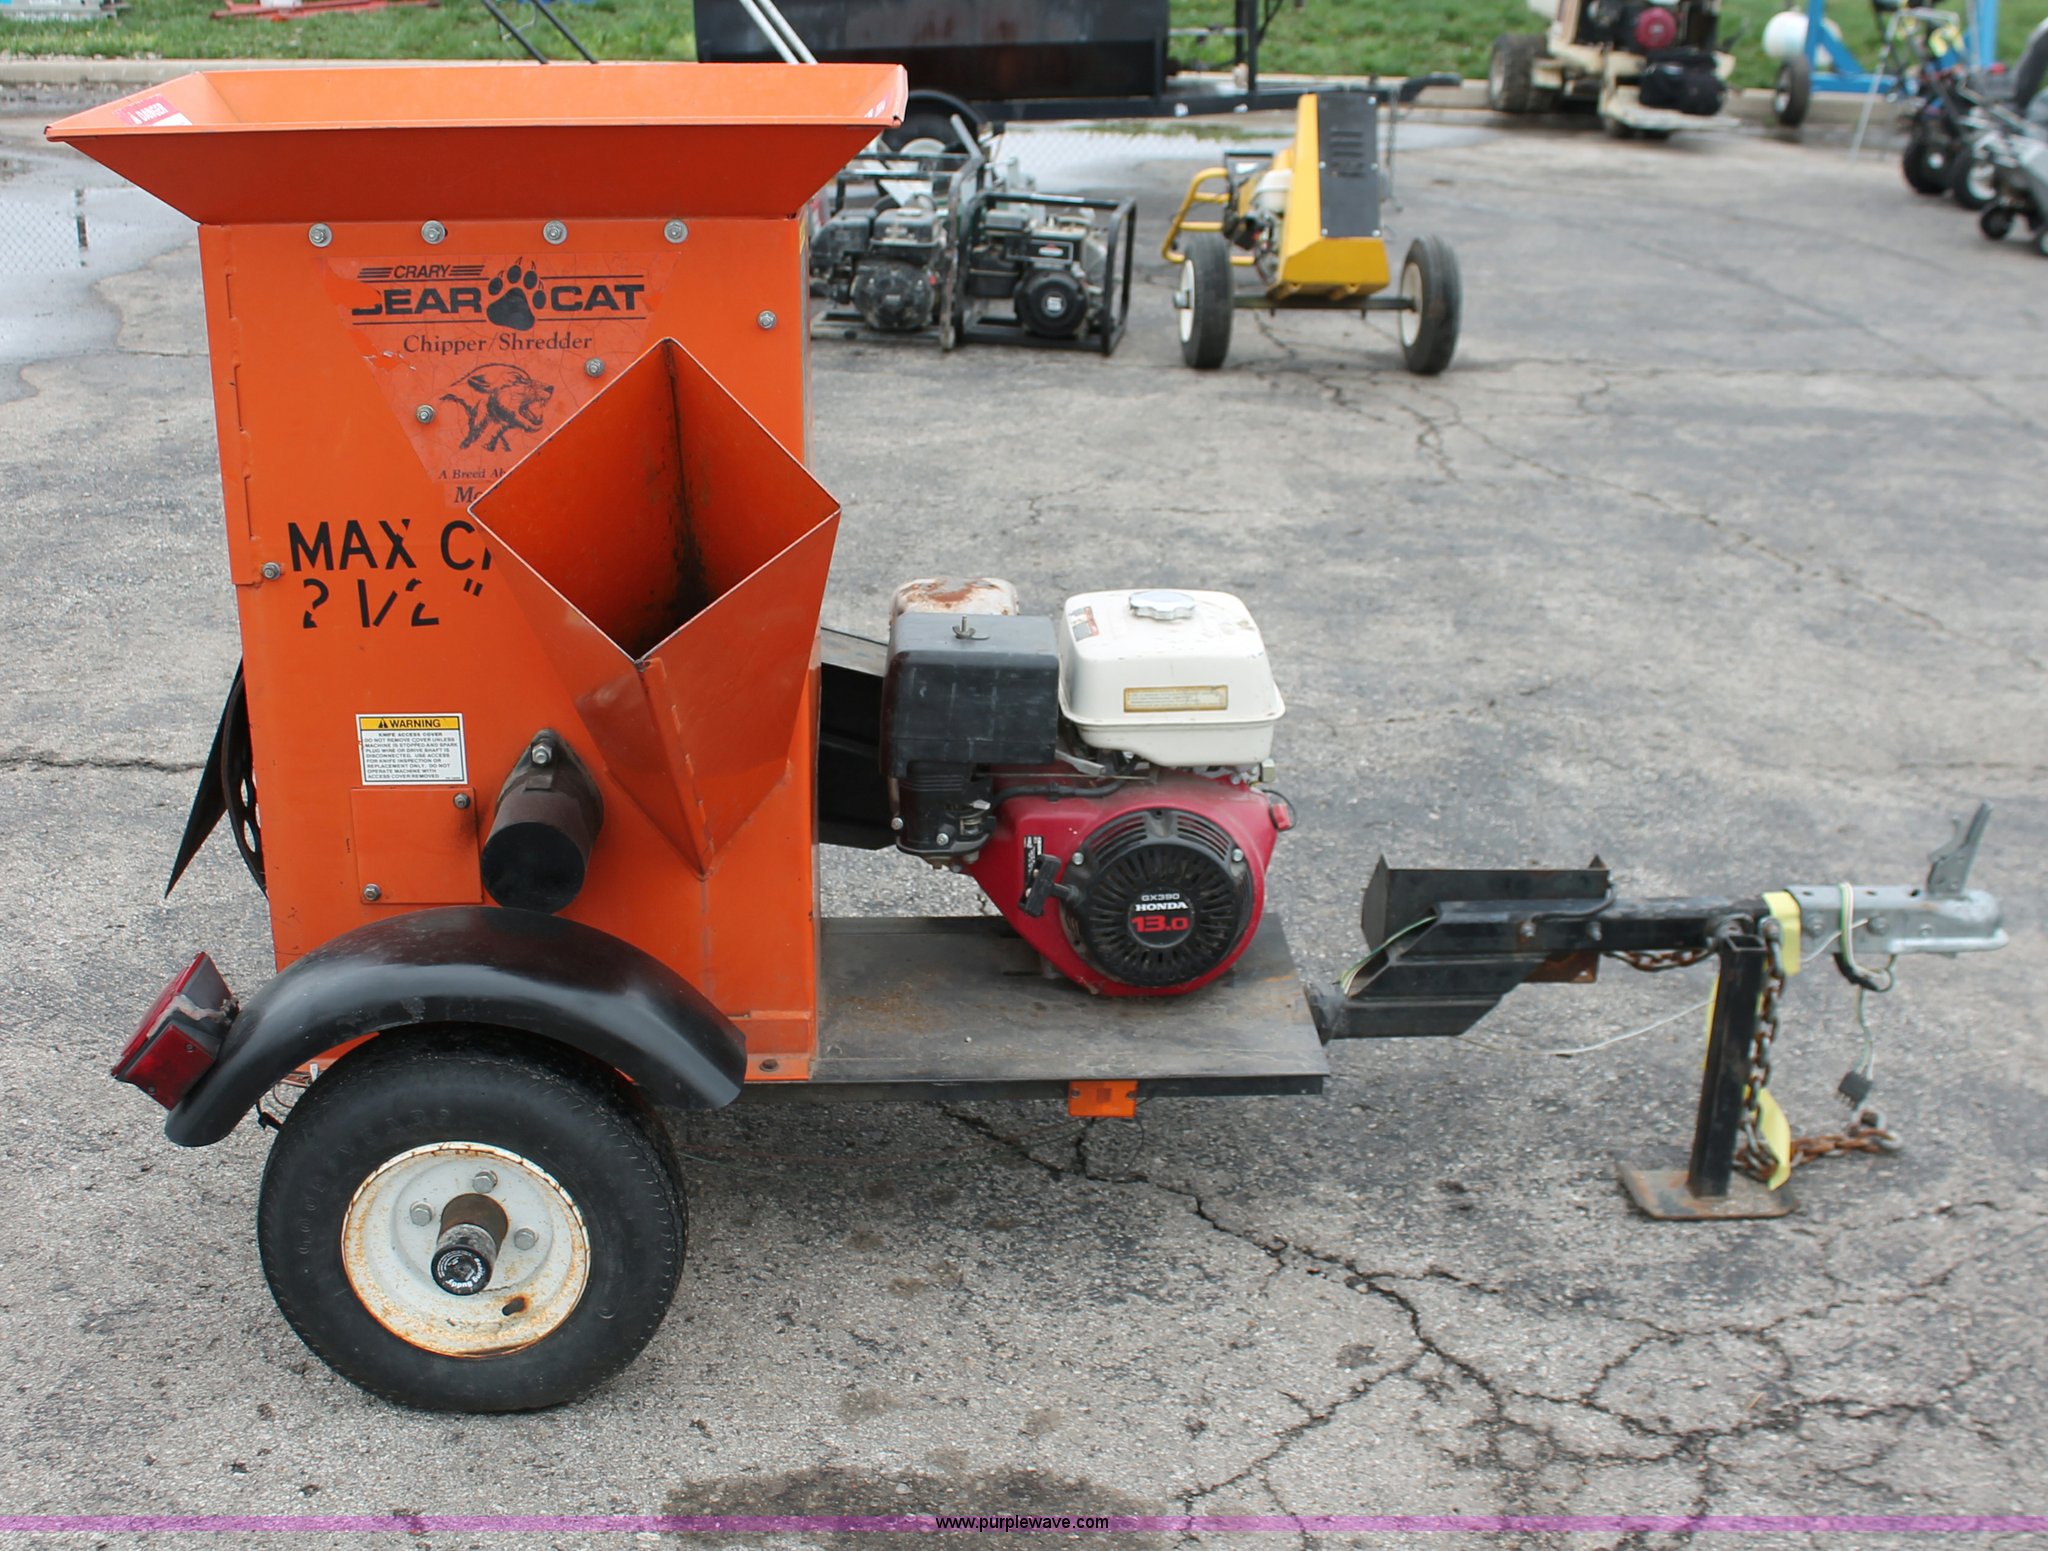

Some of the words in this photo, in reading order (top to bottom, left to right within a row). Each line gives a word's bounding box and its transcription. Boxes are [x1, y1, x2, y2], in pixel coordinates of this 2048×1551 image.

[393, 265, 450, 279] CRARY
[551, 284, 645, 311] CAT
[439, 469, 447, 479] A
[453, 468, 485, 479] Breed
[288, 519, 417, 572] MAX
[390, 719, 441, 728] WARNING
[1135, 902, 1188, 911] HONDA
[1130, 915, 1189, 932] 13.0
